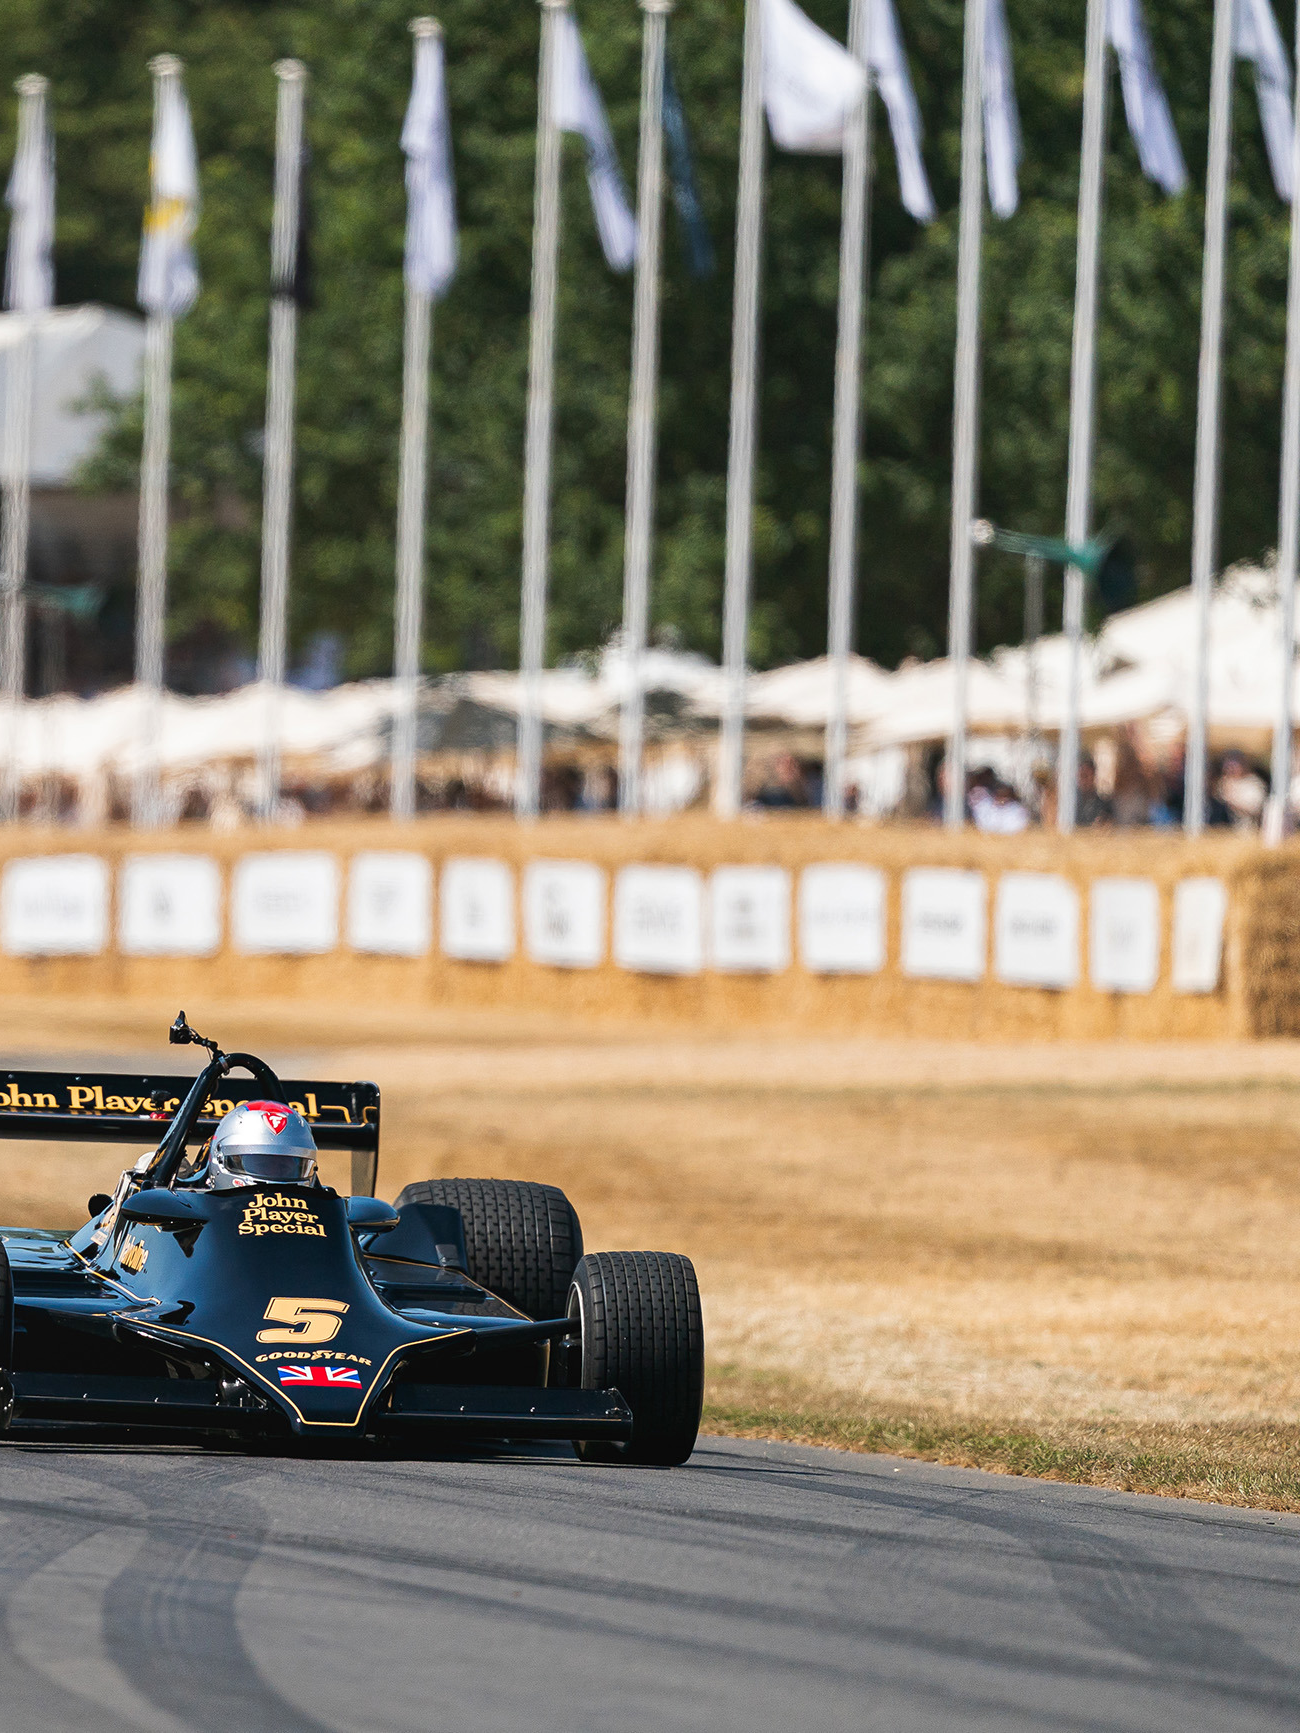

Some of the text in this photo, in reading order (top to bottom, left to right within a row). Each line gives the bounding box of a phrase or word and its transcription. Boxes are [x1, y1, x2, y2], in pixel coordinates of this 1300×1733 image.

[248, 1192, 309, 1210] John
[242, 1207, 319, 1224] Player
[238, 1221, 327, 1238] Special
[255, 1296, 351, 1344] 5
[255, 1350, 372, 1367] GOODYEAR
